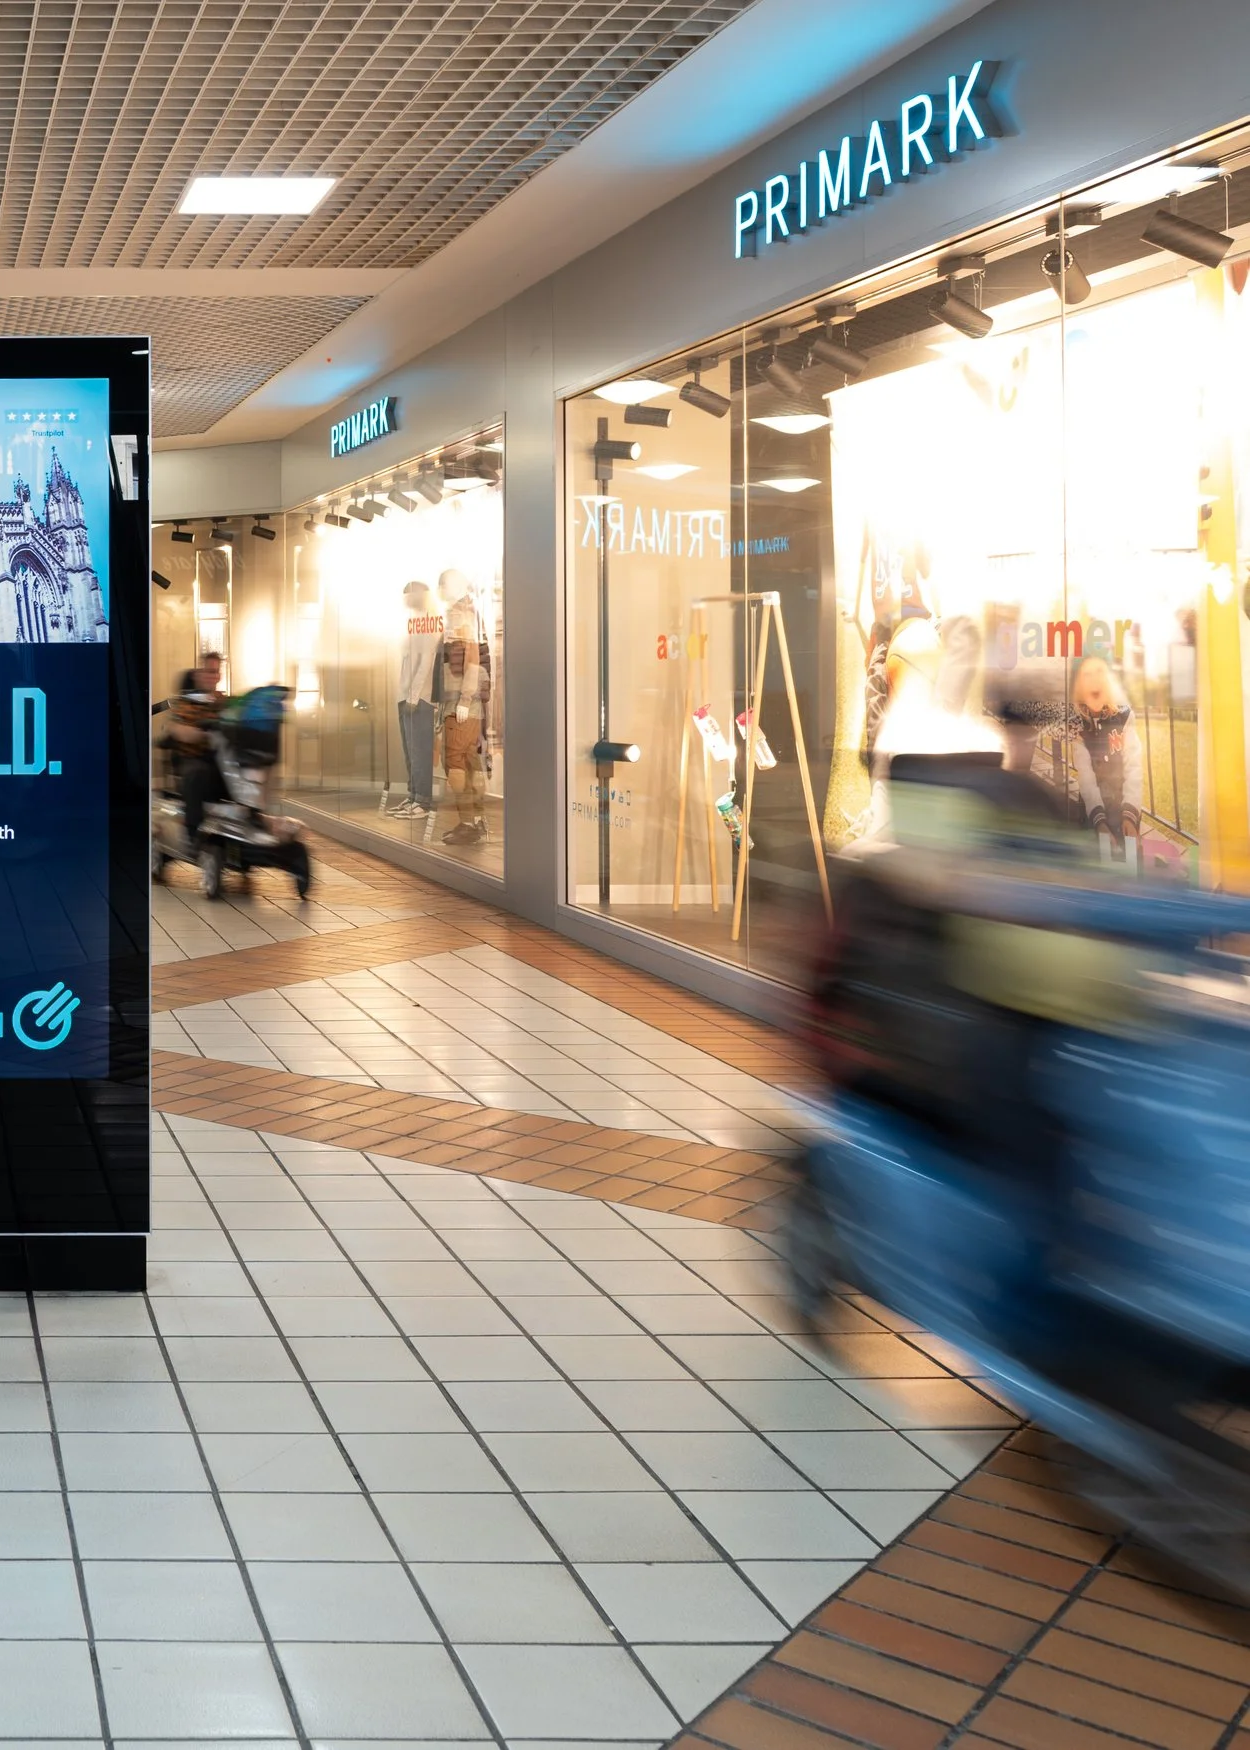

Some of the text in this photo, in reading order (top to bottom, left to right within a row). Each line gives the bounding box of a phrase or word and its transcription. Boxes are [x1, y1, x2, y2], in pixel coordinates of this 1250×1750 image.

[735, 60, 986, 259] PRIMARK
[31, 430, 65, 438] Trustpilot
[331, 396, 389, 458] PRIMARK
[408, 611, 444, 635] creators
[996, 618, 1133, 671] gamer
[572, 802, 632, 828] PRIMA.com
